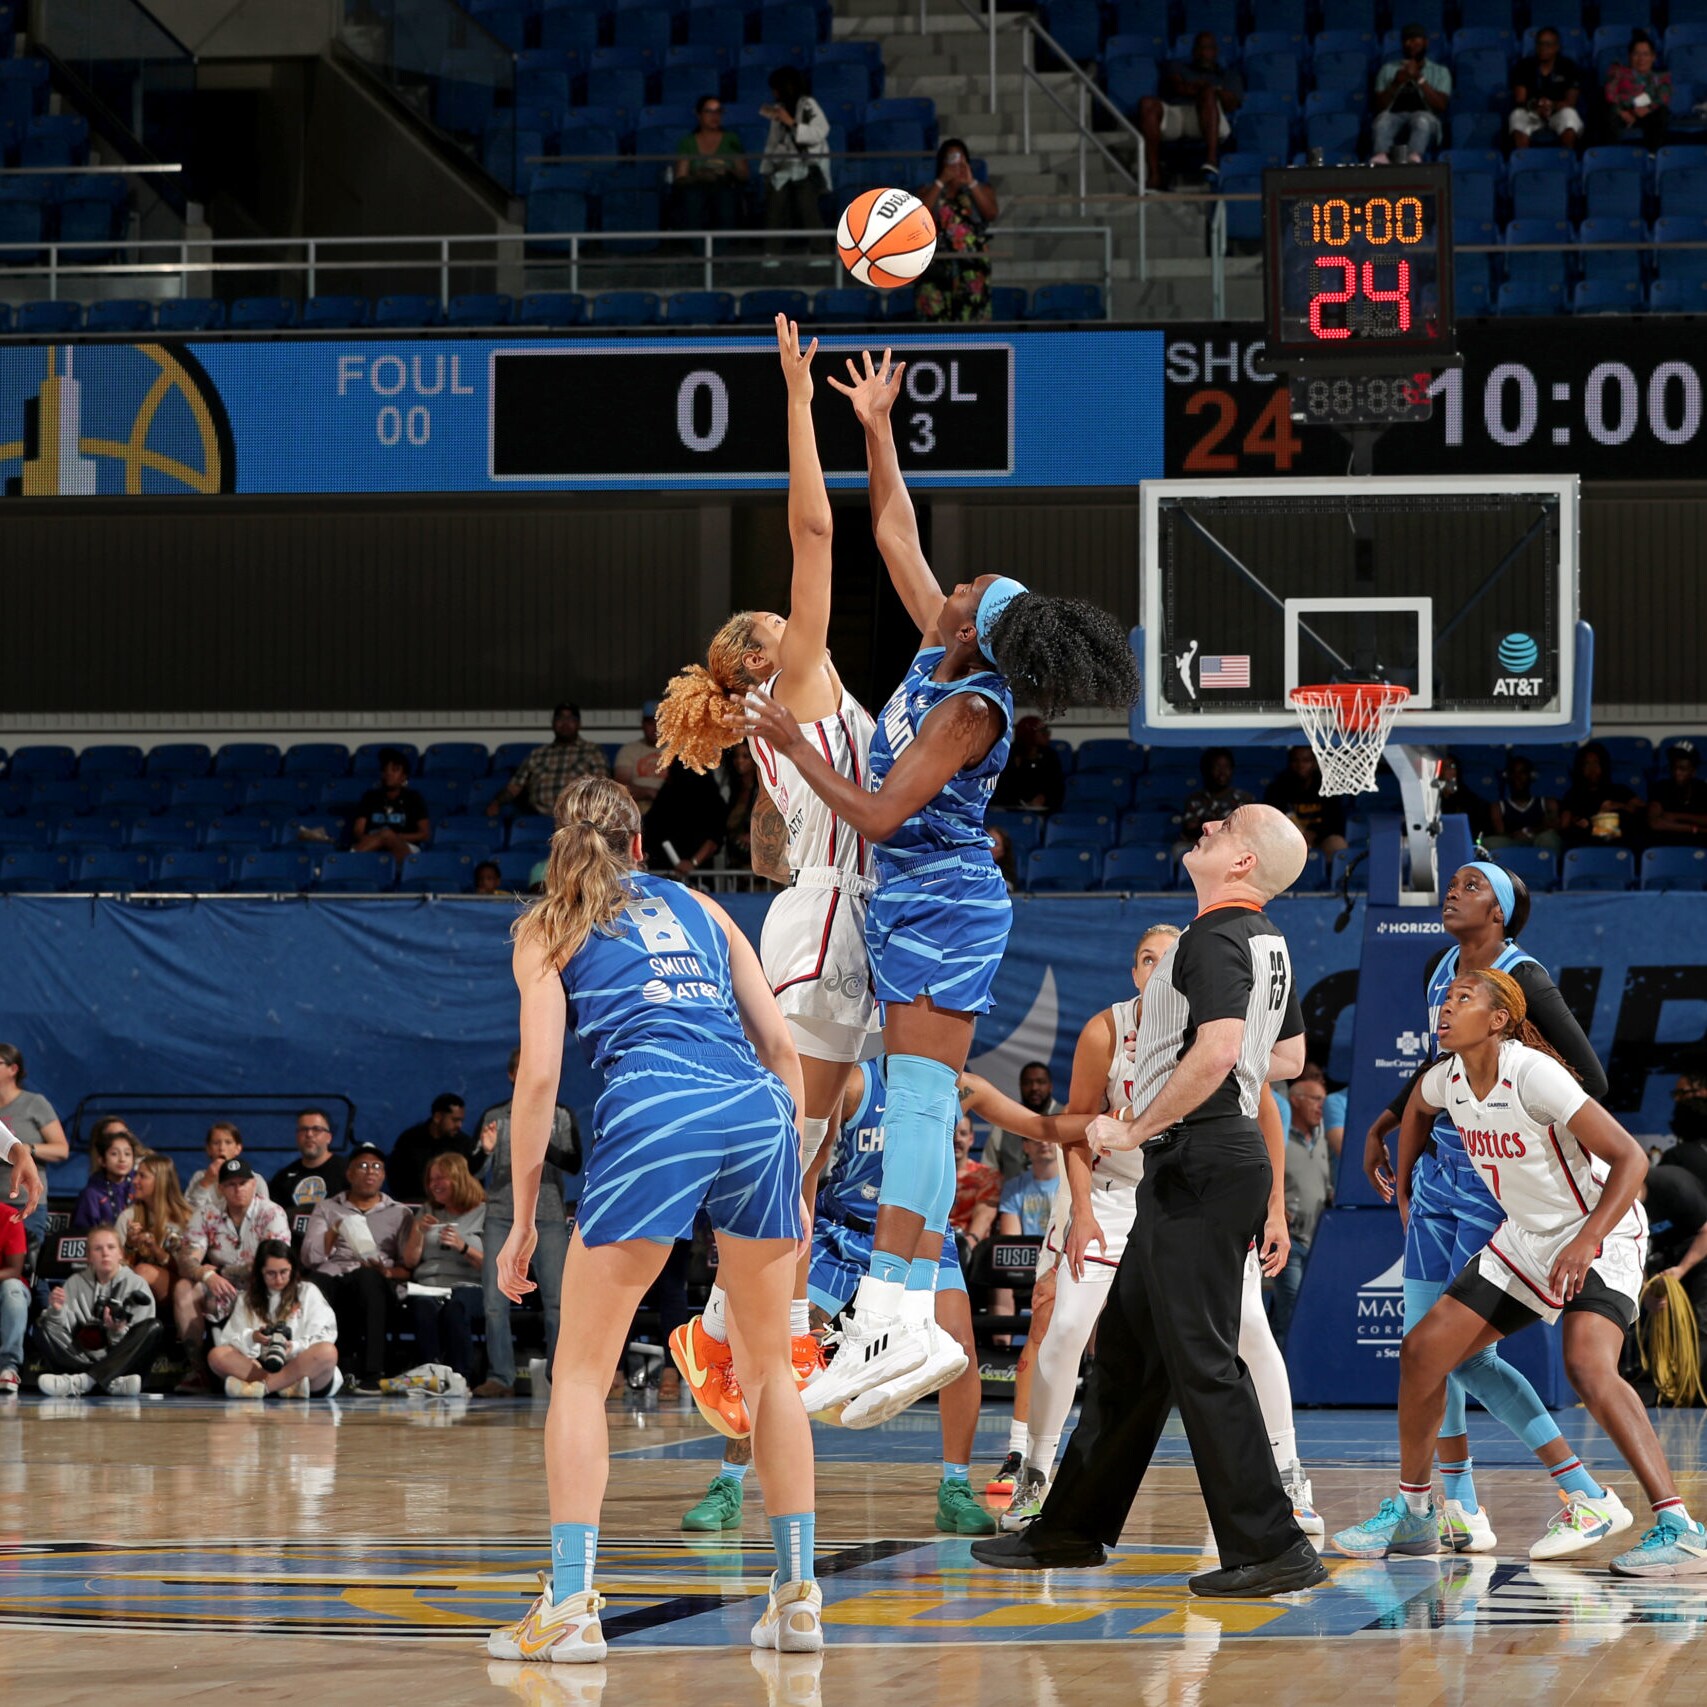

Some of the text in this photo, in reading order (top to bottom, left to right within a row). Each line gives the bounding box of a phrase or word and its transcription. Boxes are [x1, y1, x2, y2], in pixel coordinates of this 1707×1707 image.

[1312, 197, 1423, 246] 10:00
[1309, 256, 1411, 339] 24
[337, 354, 474, 395] FOUL
[676, 370, 729, 452] 0
[1428, 361, 1702, 447] 10:00
[376, 405, 431, 446] 00
[908, 412, 936, 453] 3
[1182, 388, 1303, 473] 24
[1492, 677, 1544, 697] AT&T
[625, 896, 691, 954] 8
[648, 956, 703, 977] SMITH
[1268, 950, 1287, 1011] 23
[676, 982, 721, 999] AT&T
[1481, 1163, 1502, 1201] 7
[1002, 1248, 1031, 1266] USO
